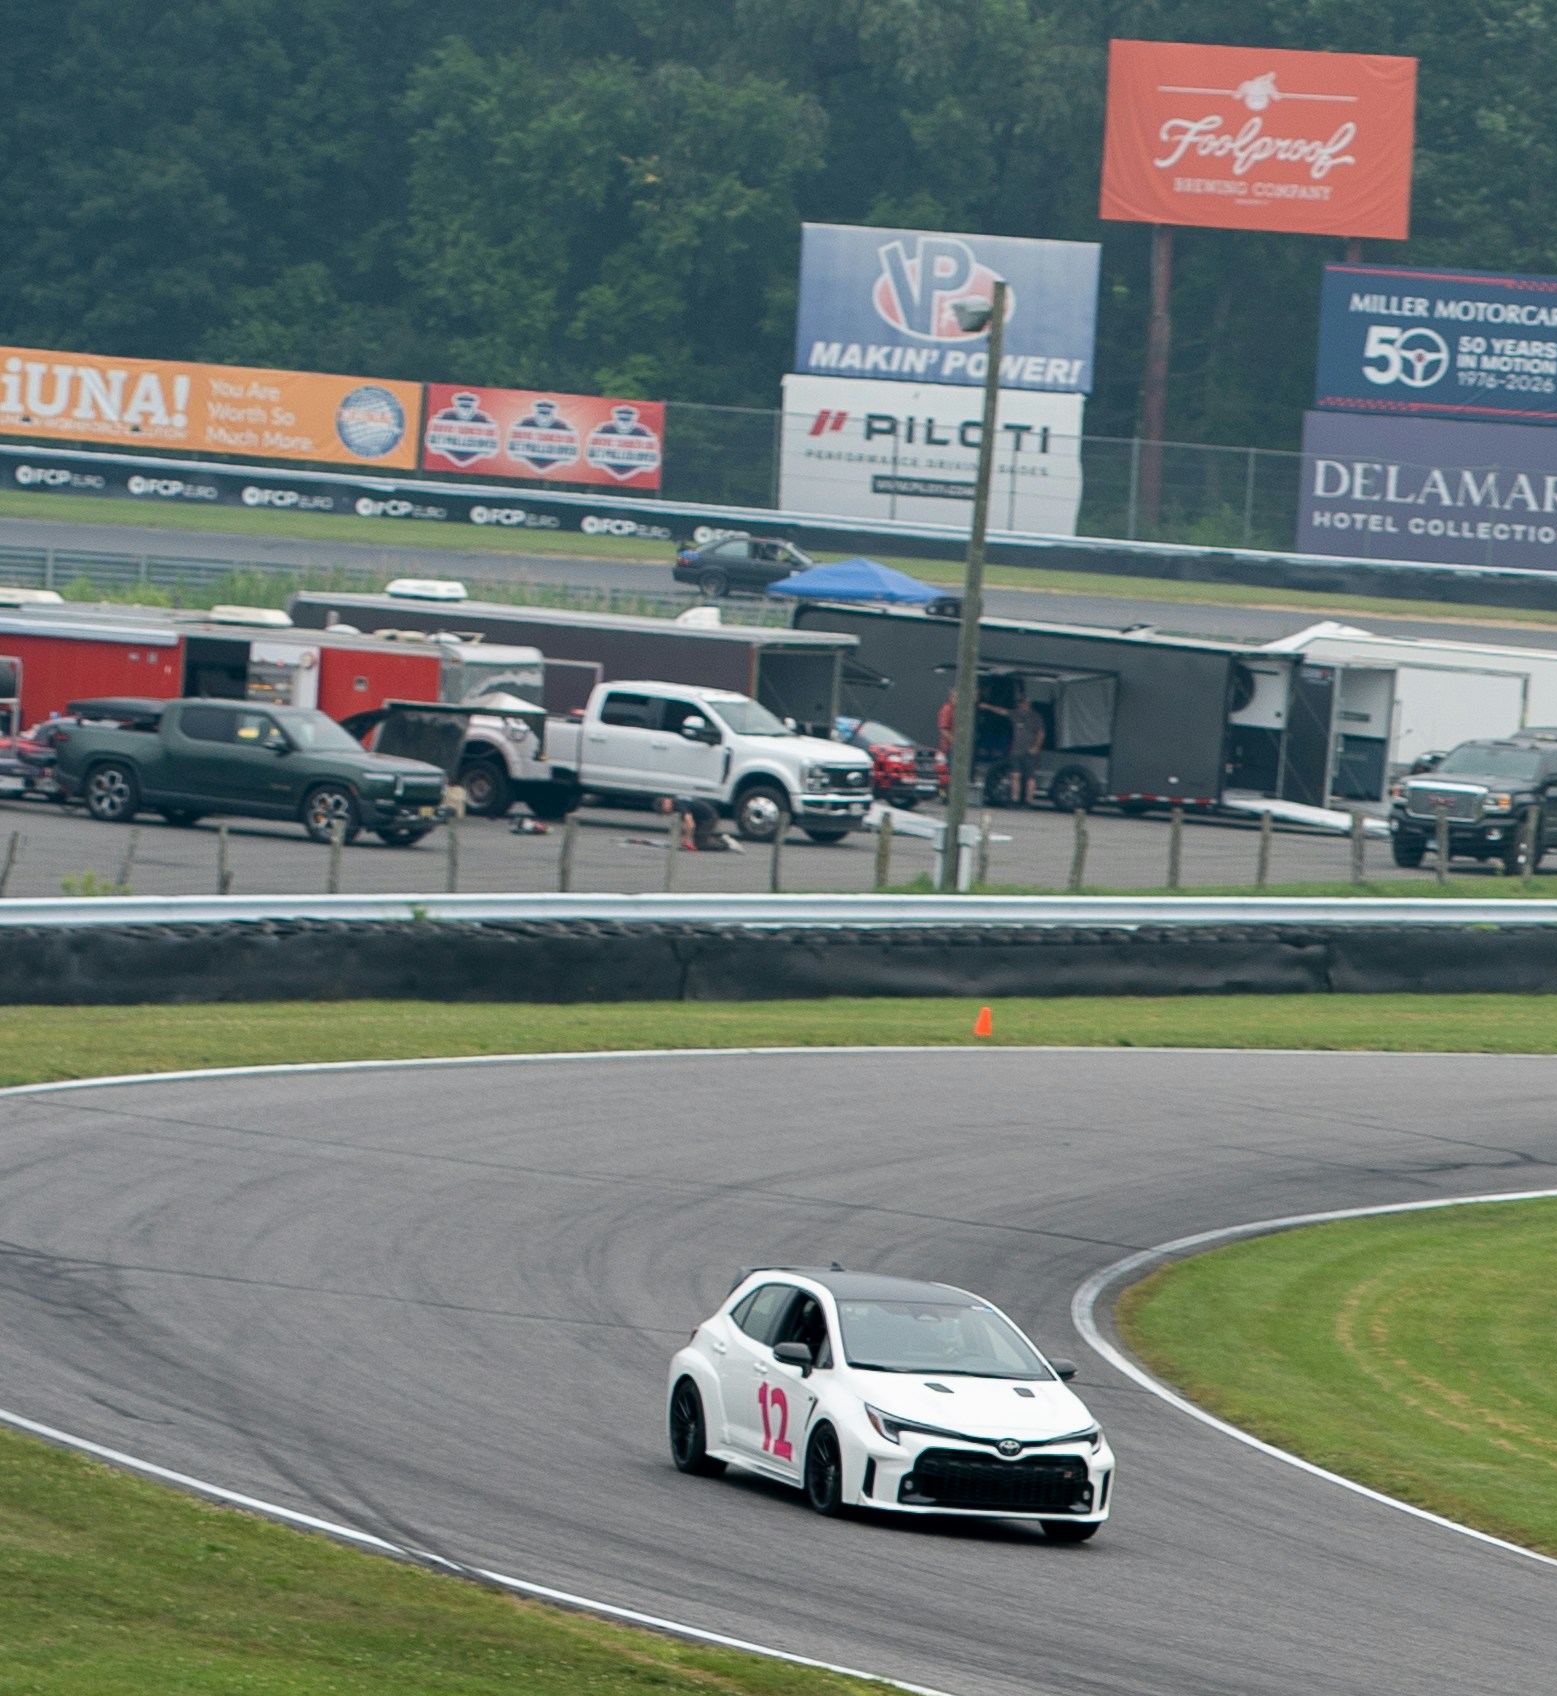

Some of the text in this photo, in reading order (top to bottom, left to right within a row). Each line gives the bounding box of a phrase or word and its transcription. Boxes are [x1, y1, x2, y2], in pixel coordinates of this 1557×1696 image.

[1153, 114, 1357, 179] Foolproof
[1252, 183, 1333, 200] COMPANY
[878, 236, 975, 336] VP
[1349, 293, 1429, 318] MILLER
[1458, 336, 1486, 353] 50
[942, 350, 1085, 384] POWER!
[1457, 355, 1557, 375] IN MOTION
[211, 379, 281, 402] You Are
[207, 402, 297, 427] Worth So
[206, 426, 258, 447] Much
[864, 413, 1049, 454] PILOTI
[1312, 511, 1399, 533] HOTEL
[757, 1381, 793, 1462] 12
